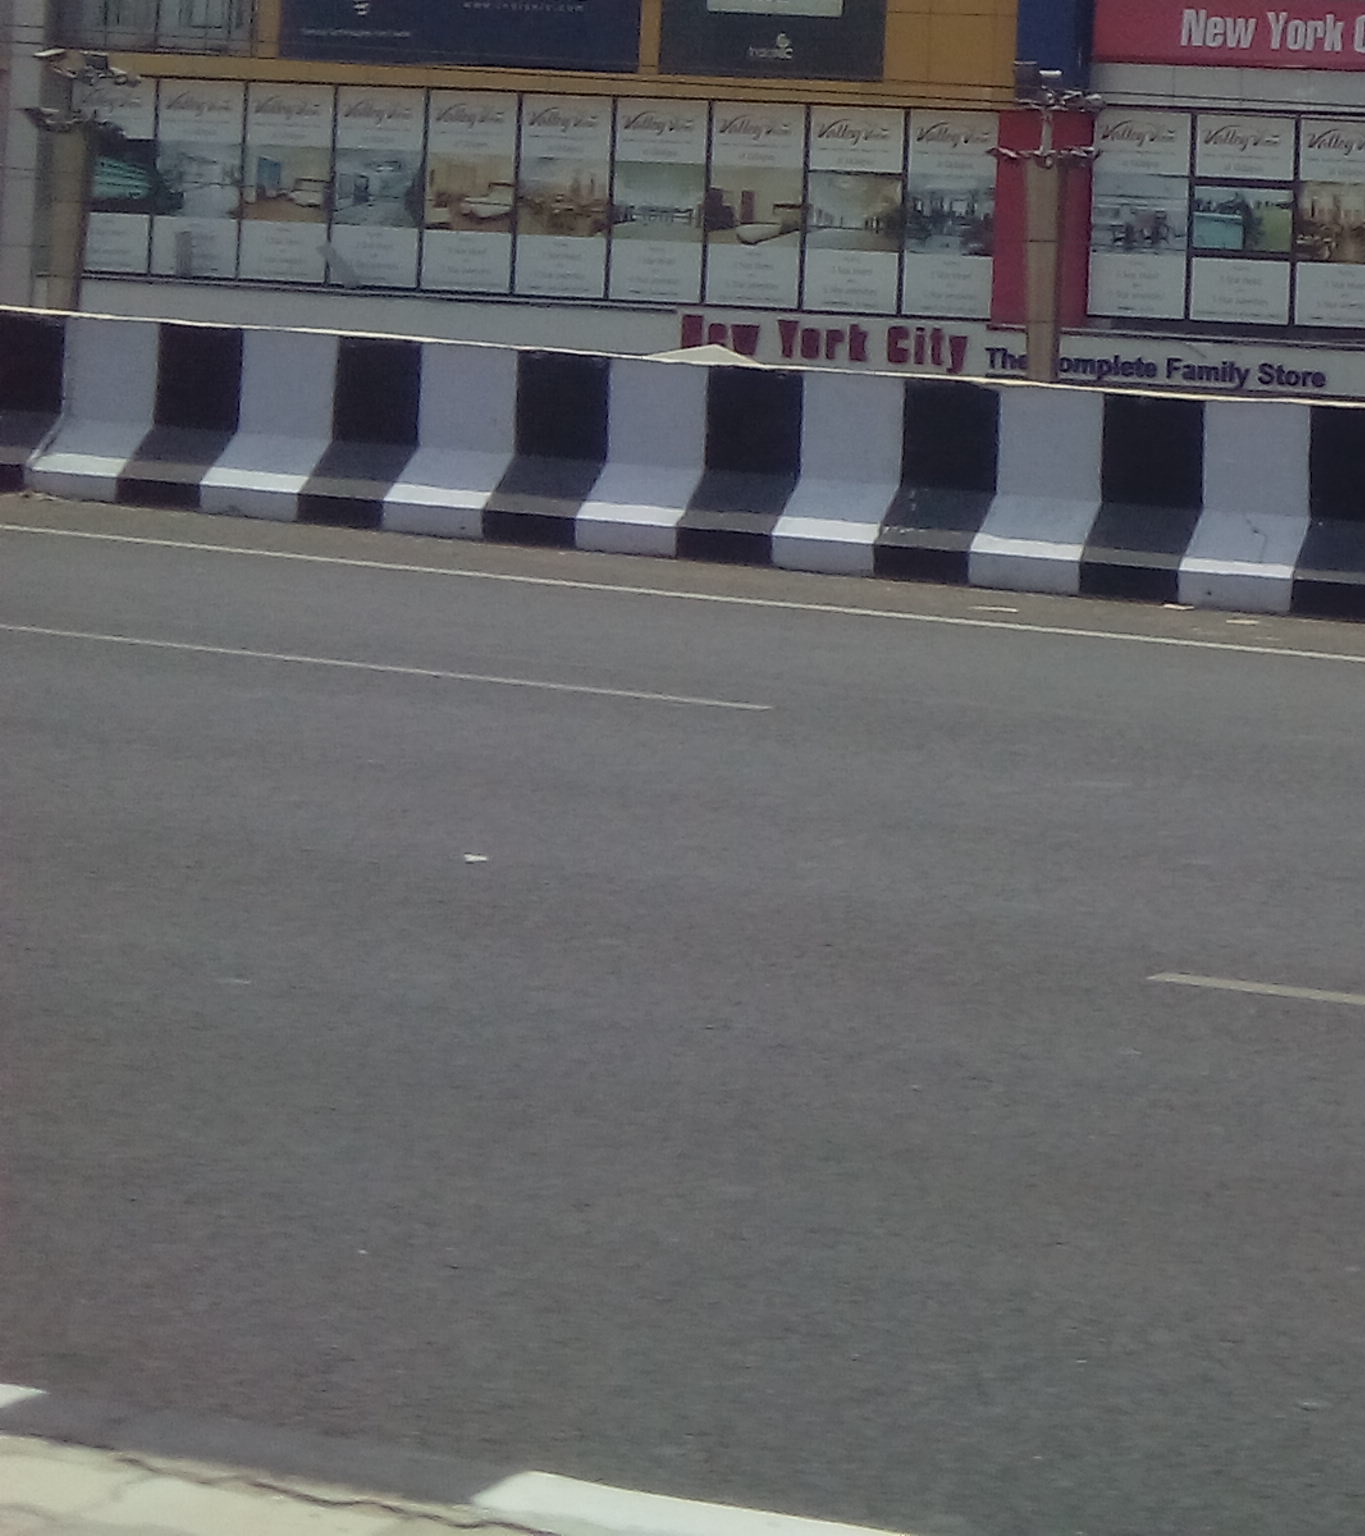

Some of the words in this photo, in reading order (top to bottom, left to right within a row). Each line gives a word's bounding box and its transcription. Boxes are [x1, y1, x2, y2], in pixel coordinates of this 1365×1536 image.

[1180, 8, 1258, 49] New
[1266, 10, 1344, 53] York
[777, 319, 868, 362] York
[887, 325, 969, 375] City
[1058, 353, 1157, 383] omplete
[1166, 357, 1250, 389] Family
[1257, 363, 1327, 389] Store
